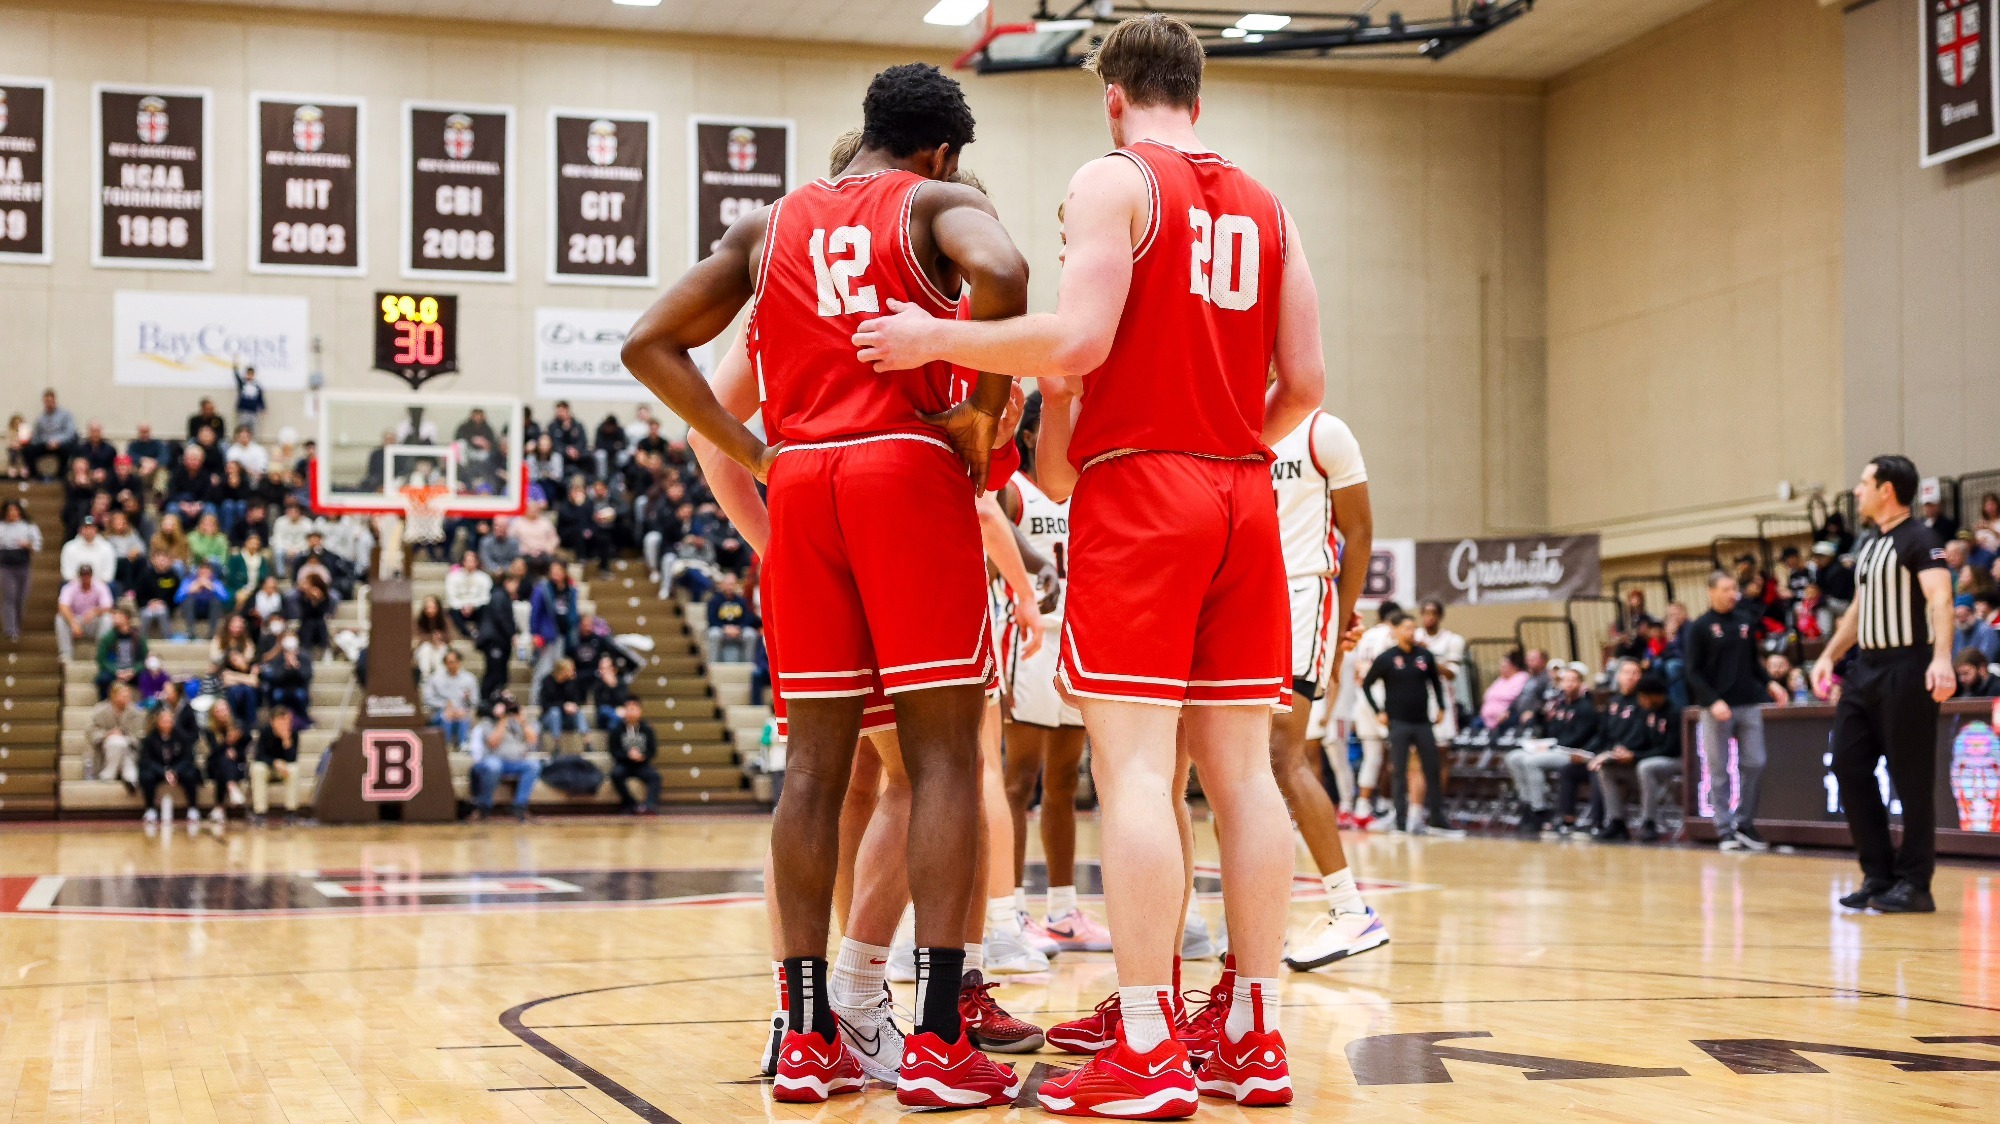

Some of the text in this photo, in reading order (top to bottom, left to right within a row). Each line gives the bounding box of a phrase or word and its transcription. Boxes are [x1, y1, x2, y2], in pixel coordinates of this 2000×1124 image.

[121, 162, 185, 189] NCAA
[285, 178, 333, 210] NIT
[435, 184, 483, 217] CBI
[580, 190, 625, 222] CIT
[719, 197, 765, 227] CB
[117, 214, 189, 248] 1986
[272, 221, 346, 254] 2003
[423, 228, 494, 260] 2008
[568, 233, 636, 265] 2014
[1188, 205, 1260, 312] 20
[808, 225, 880, 317] 12
[381, 294, 439, 324] 59.0
[138, 320, 289, 363] BayCoast
[394, 320, 443, 365] 30
[1449, 538, 1565, 604] Graduate
[362, 729, 423, 801] B
